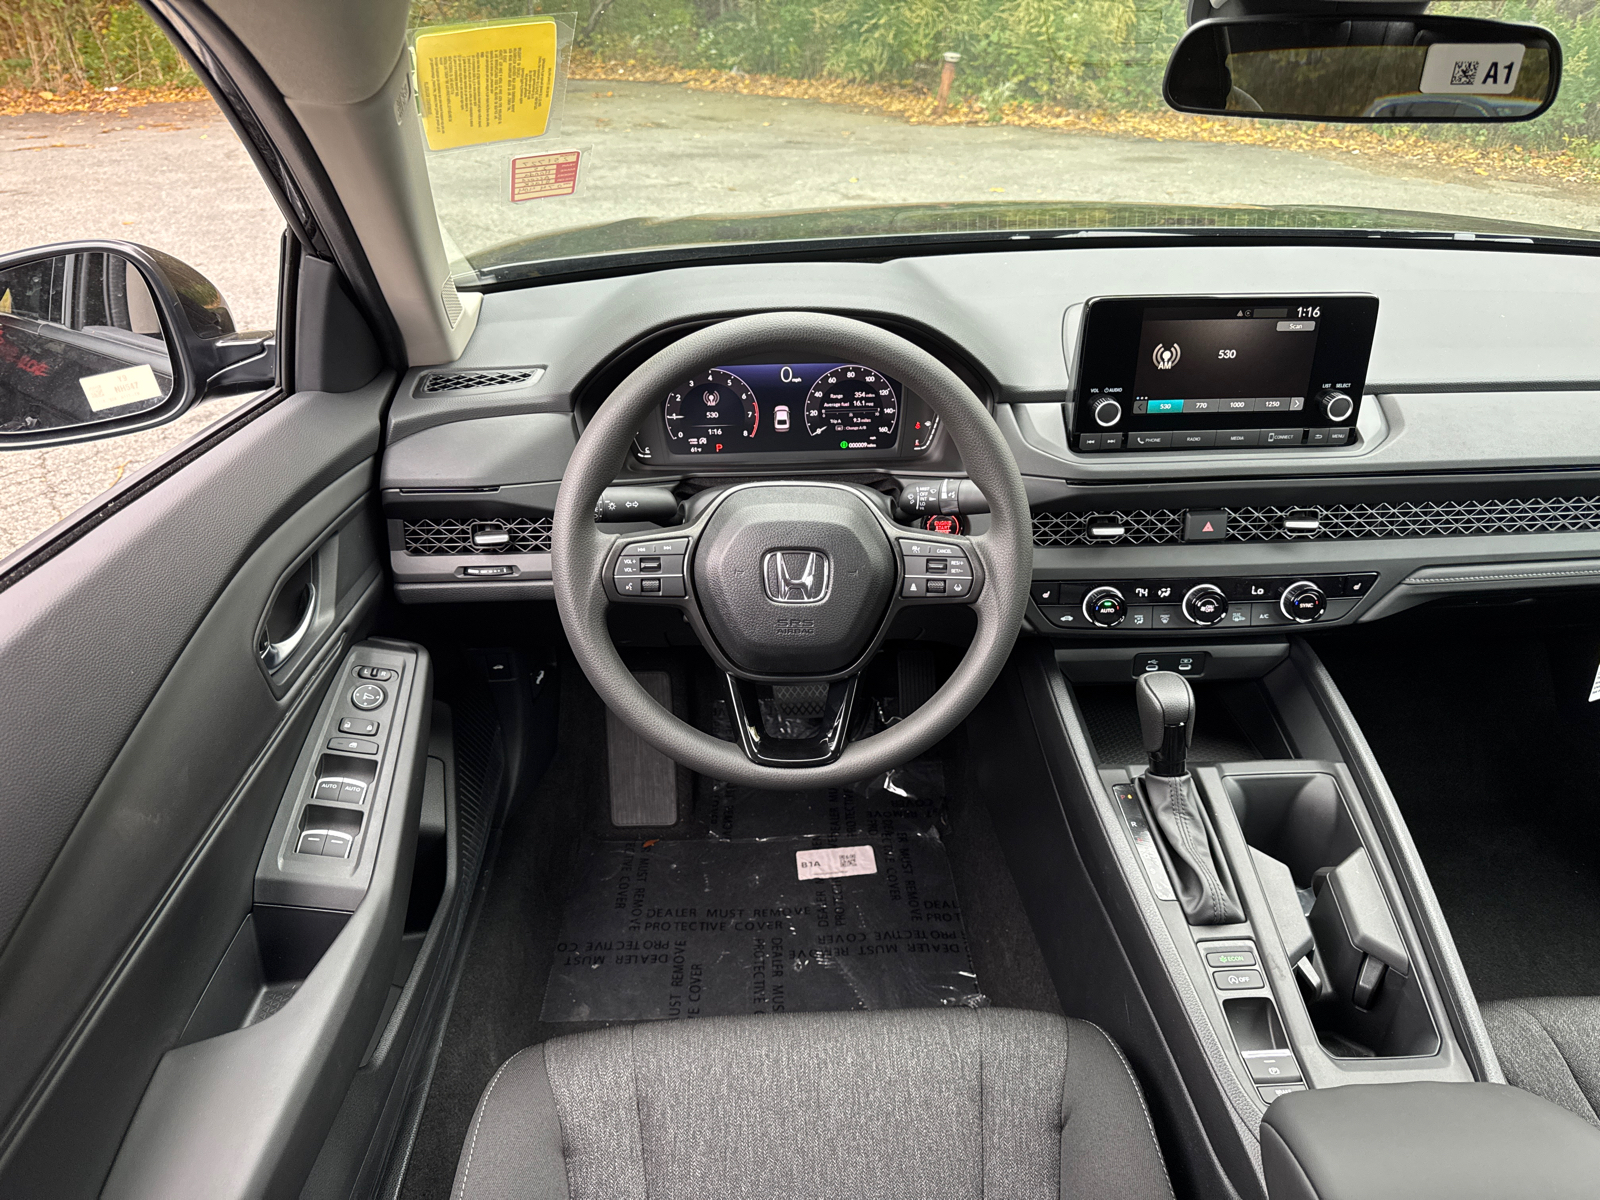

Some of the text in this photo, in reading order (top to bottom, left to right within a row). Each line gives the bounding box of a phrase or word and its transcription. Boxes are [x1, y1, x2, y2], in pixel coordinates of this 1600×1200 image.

[1481, 62, 1515, 85] A1
[1297, 307, 1320, 318] 1:16
[1218, 350, 1236, 359] 530
[1157, 362, 1172, 370] AM
[780, 366, 792, 383] 0
[676, 394, 681, 402] 2
[706, 411, 719, 419] 530
[716, 443, 723, 452] P
[1135, 588, 1148, 597] 74
[1251, 586, 1264, 595] Lo
[777, 619, 815, 627] SRS
[646, 907, 811, 918] DEALER MUST REMOVE
[644, 921, 783, 931] PROTECTIVE COVER
[818, 930, 957, 945] PROTECTIVE COVER
[585, 940, 669, 952] PROTECTIVE
[858, 944, 898, 955] MUST
[907, 943, 959, 953] DEALER
[563, 954, 669, 966] DEALER MUST
[671, 939, 687, 987] REMOVE
[771, 937, 785, 1012] DEALER MUS
[688, 962, 702, 1002] COVER
